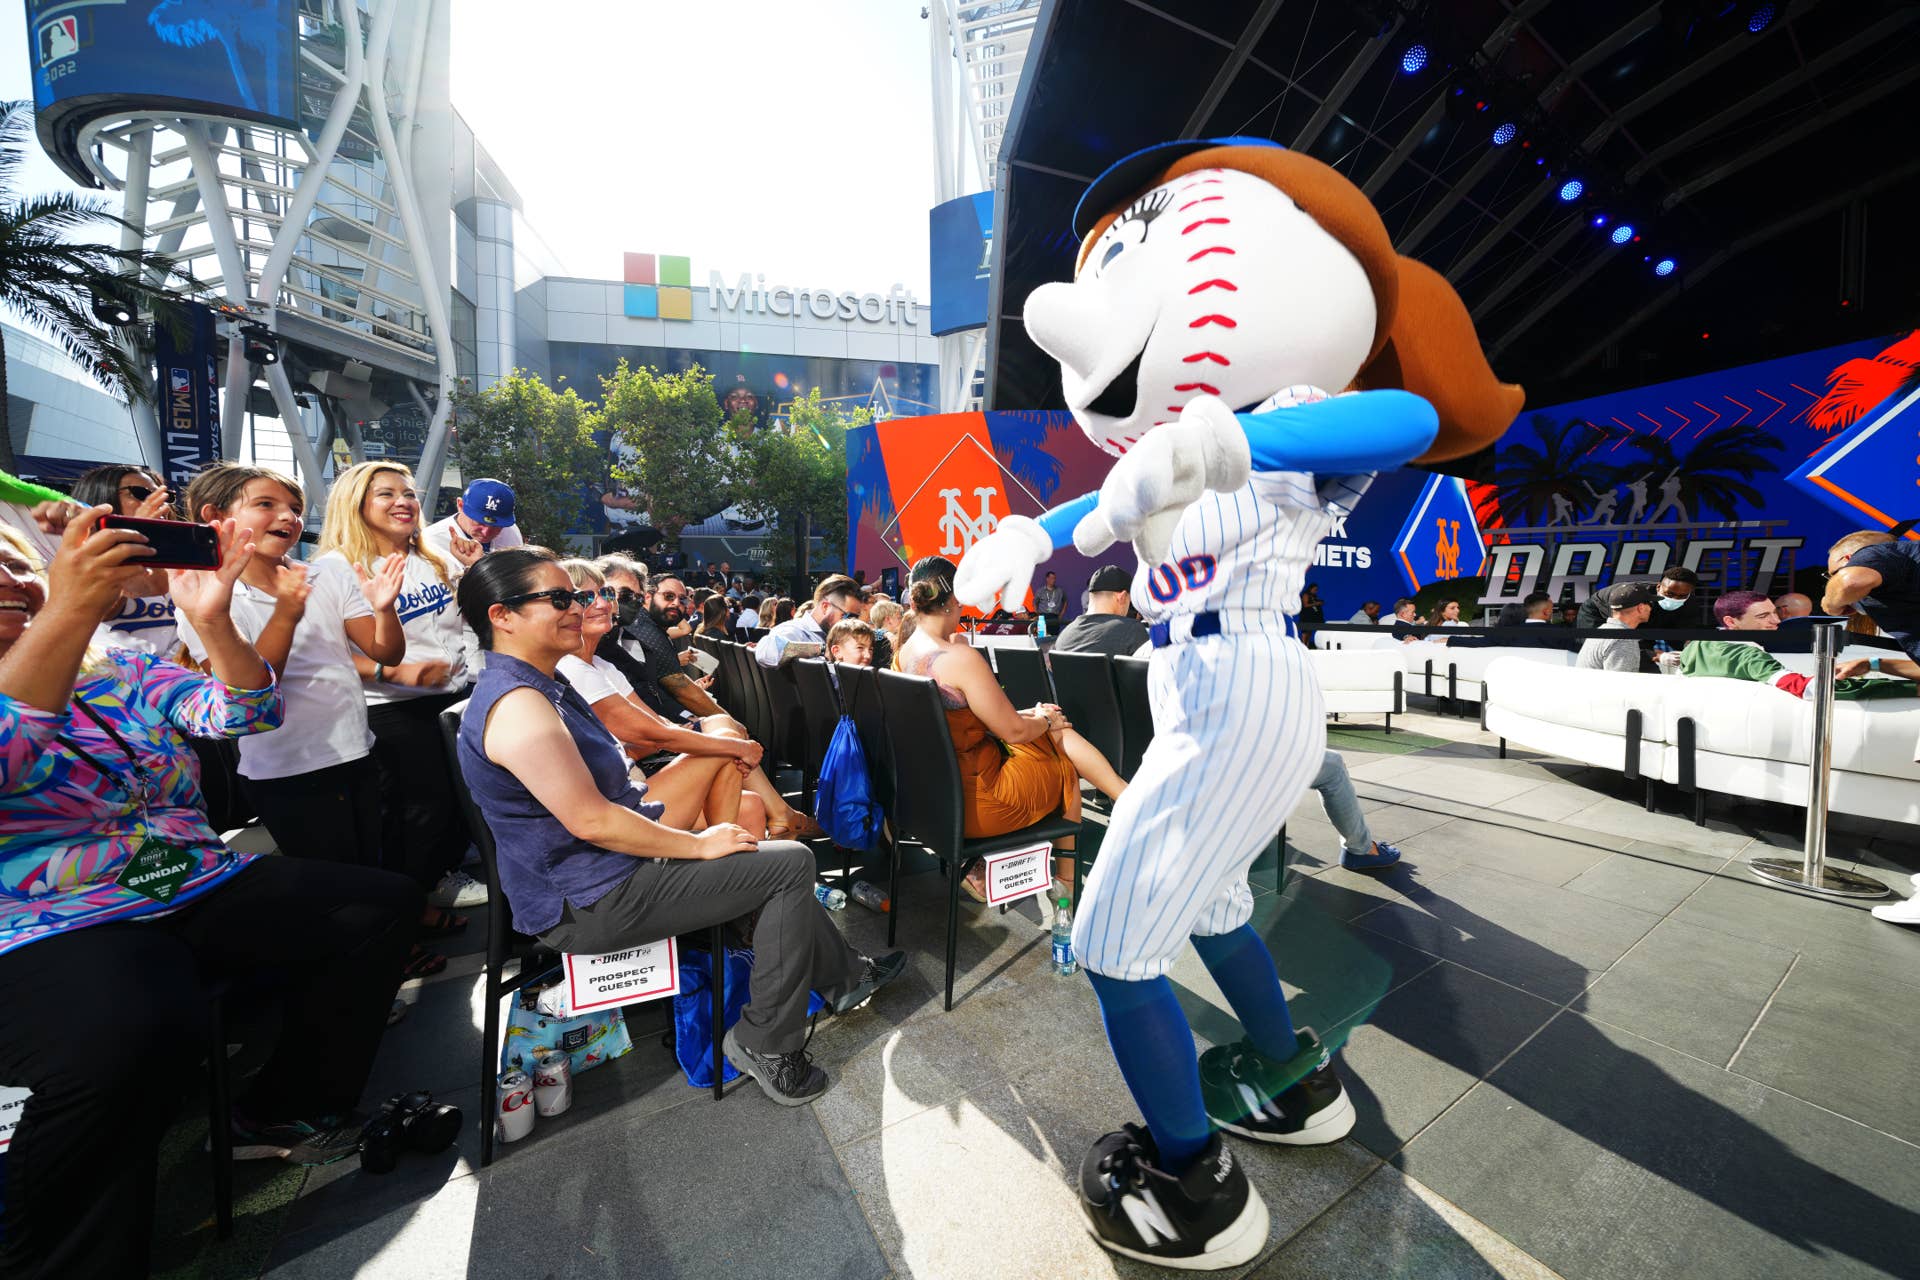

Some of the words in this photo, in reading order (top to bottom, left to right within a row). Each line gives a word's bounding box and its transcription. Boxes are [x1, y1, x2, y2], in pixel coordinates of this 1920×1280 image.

[43, 60, 77, 87] 2022
[708, 269, 918, 325] Microsoft
[173, 391, 192, 429] MLB
[127, 862, 188, 887] SUNDAY
[999, 868, 1037, 884] PROSPECT
[1004, 876, 1034, 890] GUESTS
[602, 948, 642, 965] DRAFT
[588, 965, 656, 985] PROSPECT
[597, 977, 648, 993] GUESTS
